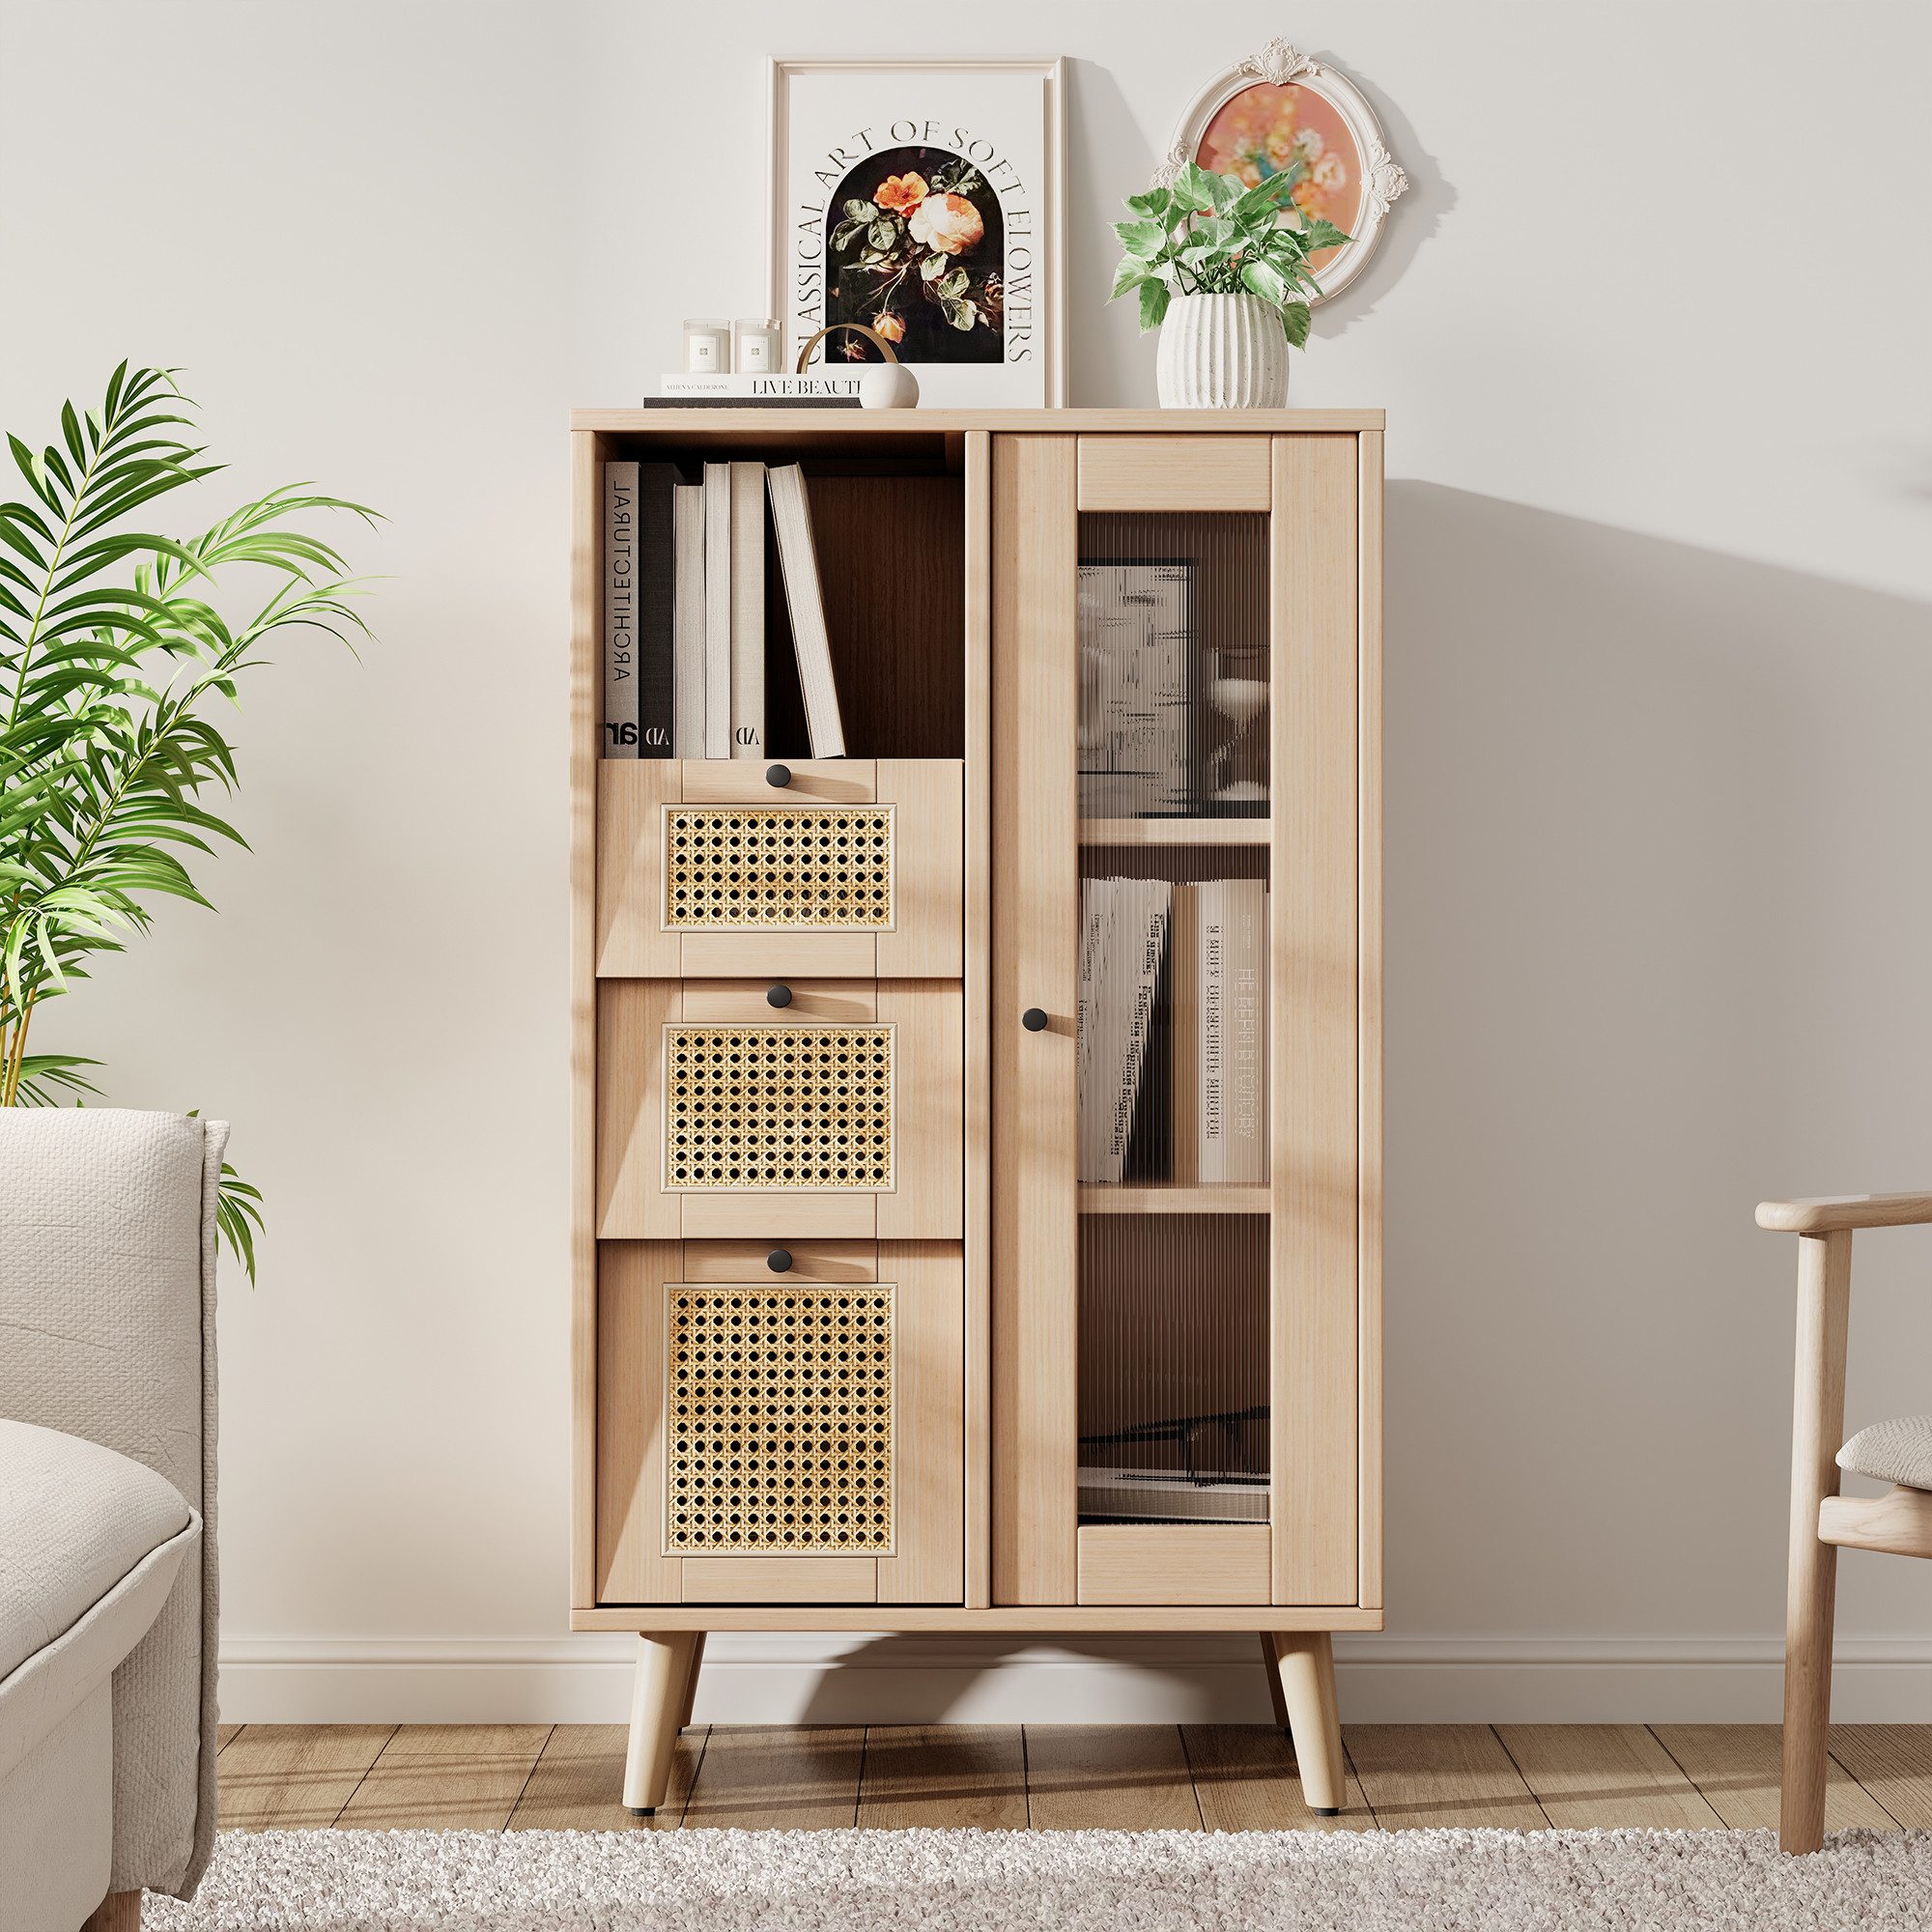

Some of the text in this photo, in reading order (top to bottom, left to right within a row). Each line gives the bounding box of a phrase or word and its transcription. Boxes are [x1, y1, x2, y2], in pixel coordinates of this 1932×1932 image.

[814, 128, 872, 191] ART
[890, 120, 941, 143] OF
[948, 128, 1027, 197] SOFT
[753, 380, 792, 394] LIVE
